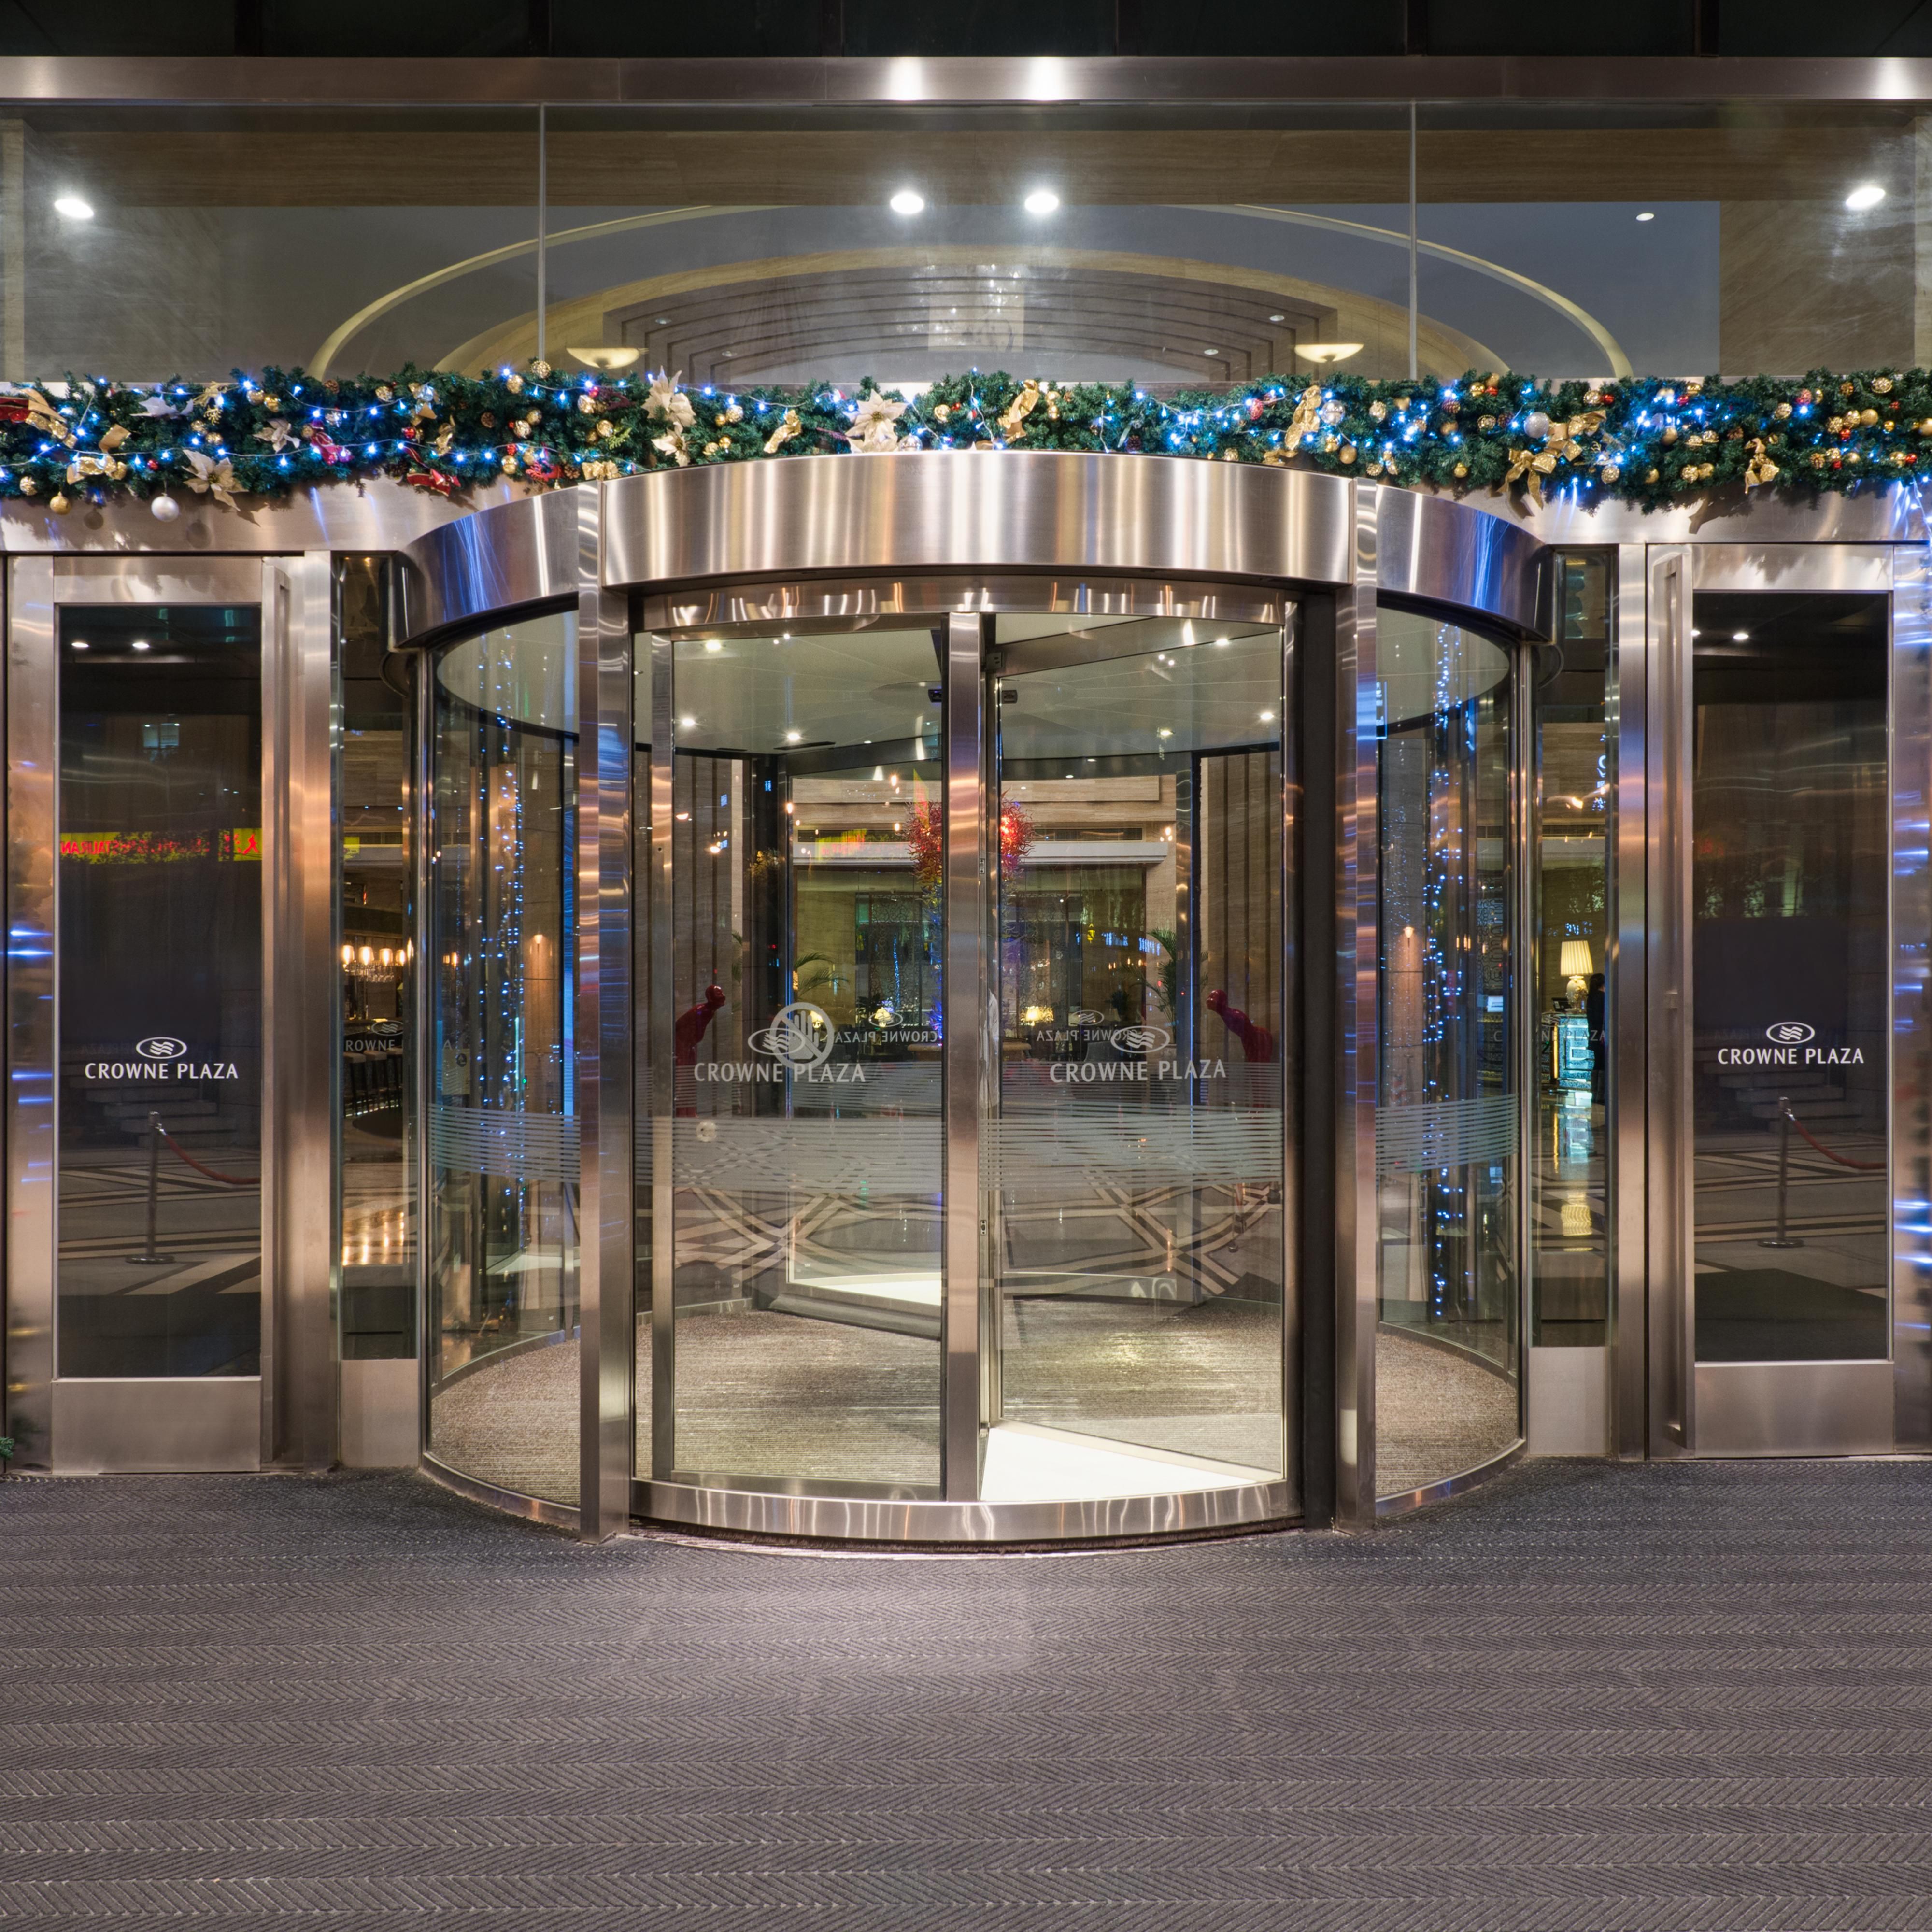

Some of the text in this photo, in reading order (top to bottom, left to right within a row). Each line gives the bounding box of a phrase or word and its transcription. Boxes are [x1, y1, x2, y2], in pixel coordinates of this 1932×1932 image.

[345, 1040, 395, 1051] ROWNE
[1718, 1048, 1864, 1064] CROWNE PLAZA
[85, 1063, 239, 1079] CROWNE PLAZA
[694, 1063, 866, 1082] CROWNE PLAZA
[1050, 1059, 1226, 1083] CROWNE PLAZA
